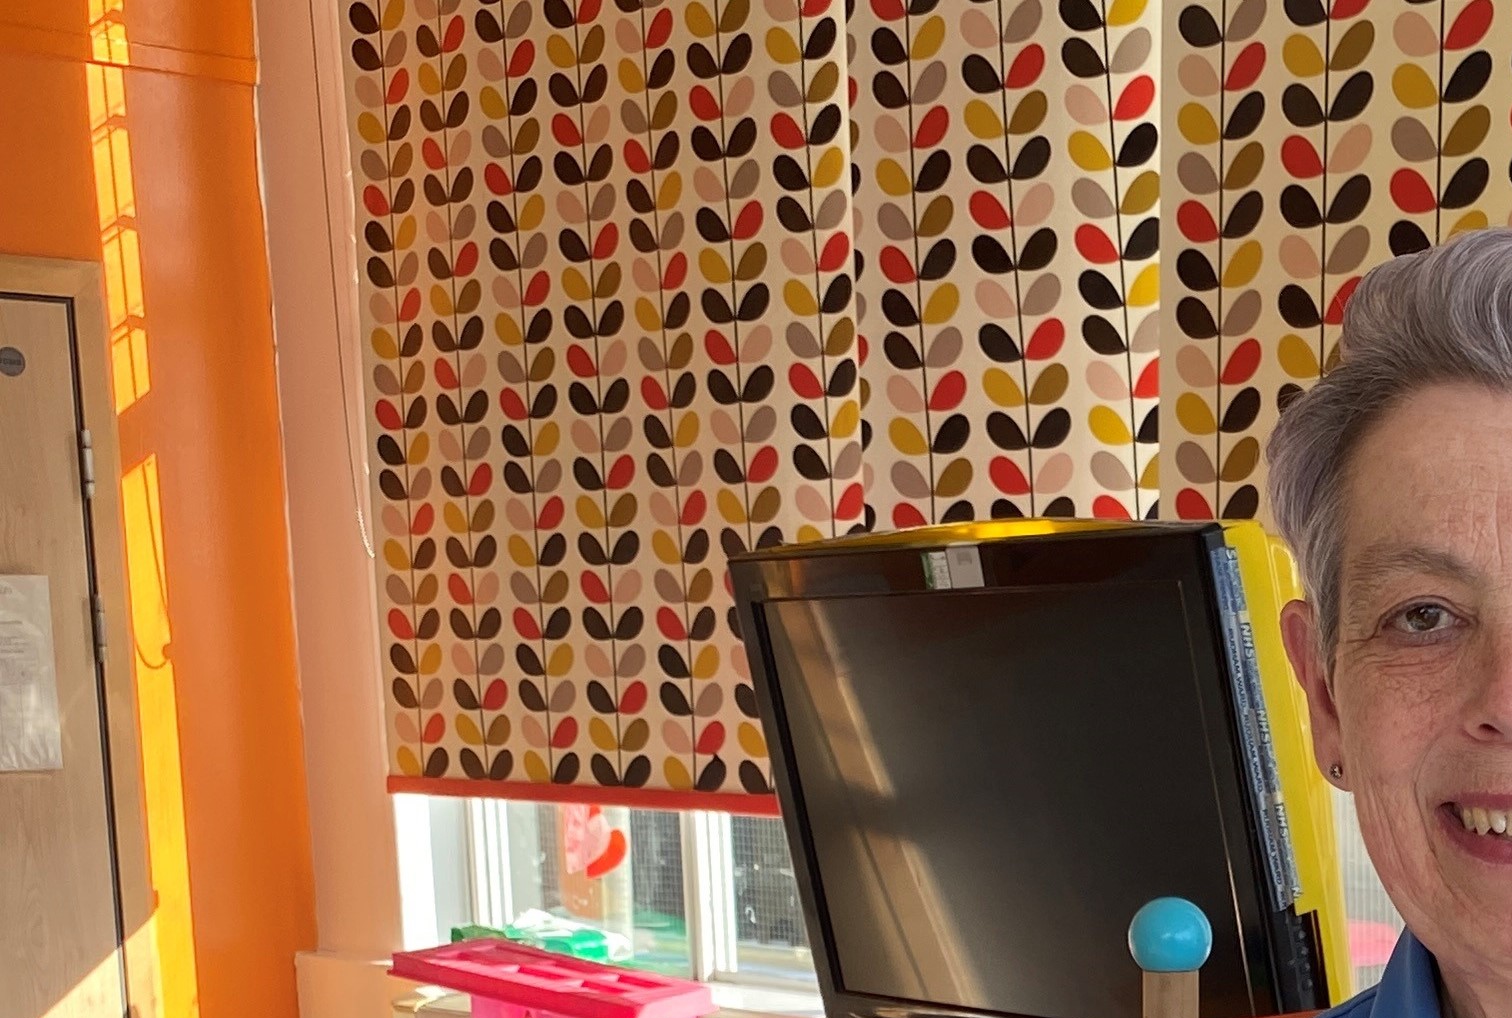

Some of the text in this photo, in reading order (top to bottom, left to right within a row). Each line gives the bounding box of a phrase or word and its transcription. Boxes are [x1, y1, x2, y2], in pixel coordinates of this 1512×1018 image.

[1240, 623, 1254, 659] NHS
[1236, 677, 1246, 707] WARD
[1257, 709, 1270, 744] NHS
[1274, 803, 1288, 838] NHS
